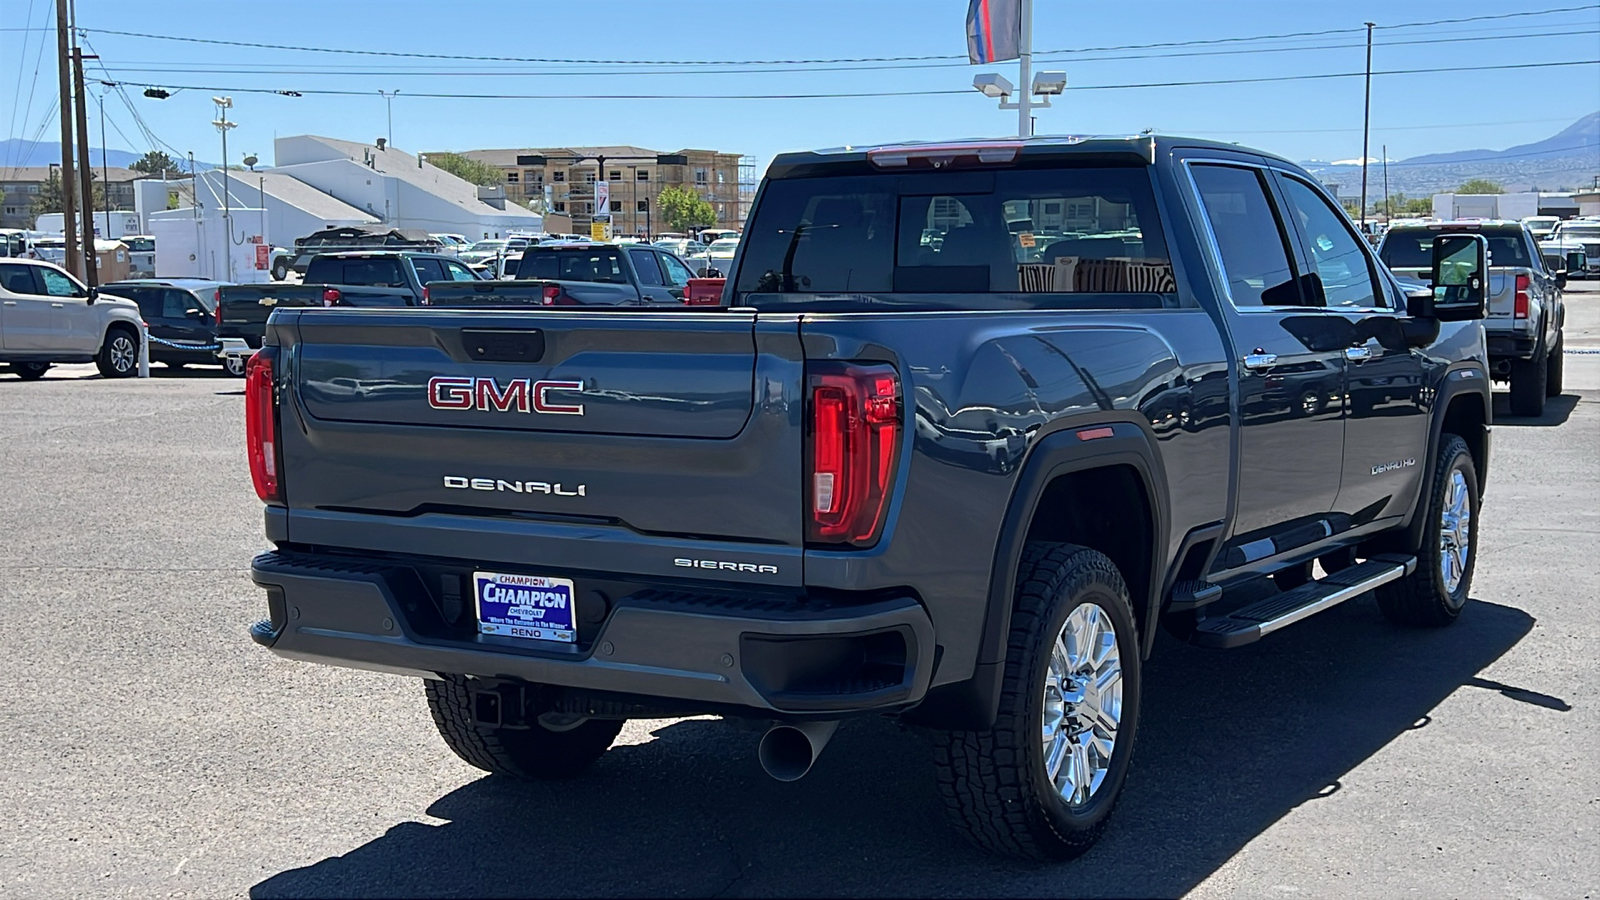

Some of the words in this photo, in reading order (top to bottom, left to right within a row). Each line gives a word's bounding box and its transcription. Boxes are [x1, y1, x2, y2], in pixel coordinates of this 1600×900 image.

[428, 376, 585, 416] GMC
[443, 475, 587, 497] DENALI
[674, 558, 778, 574] SIERRA
[499, 575, 545, 586] CHAMPION
[483, 582, 566, 609] CHAMPION
[509, 608, 543, 616] CHEVROLET
[511, 627, 542, 638] RENO
